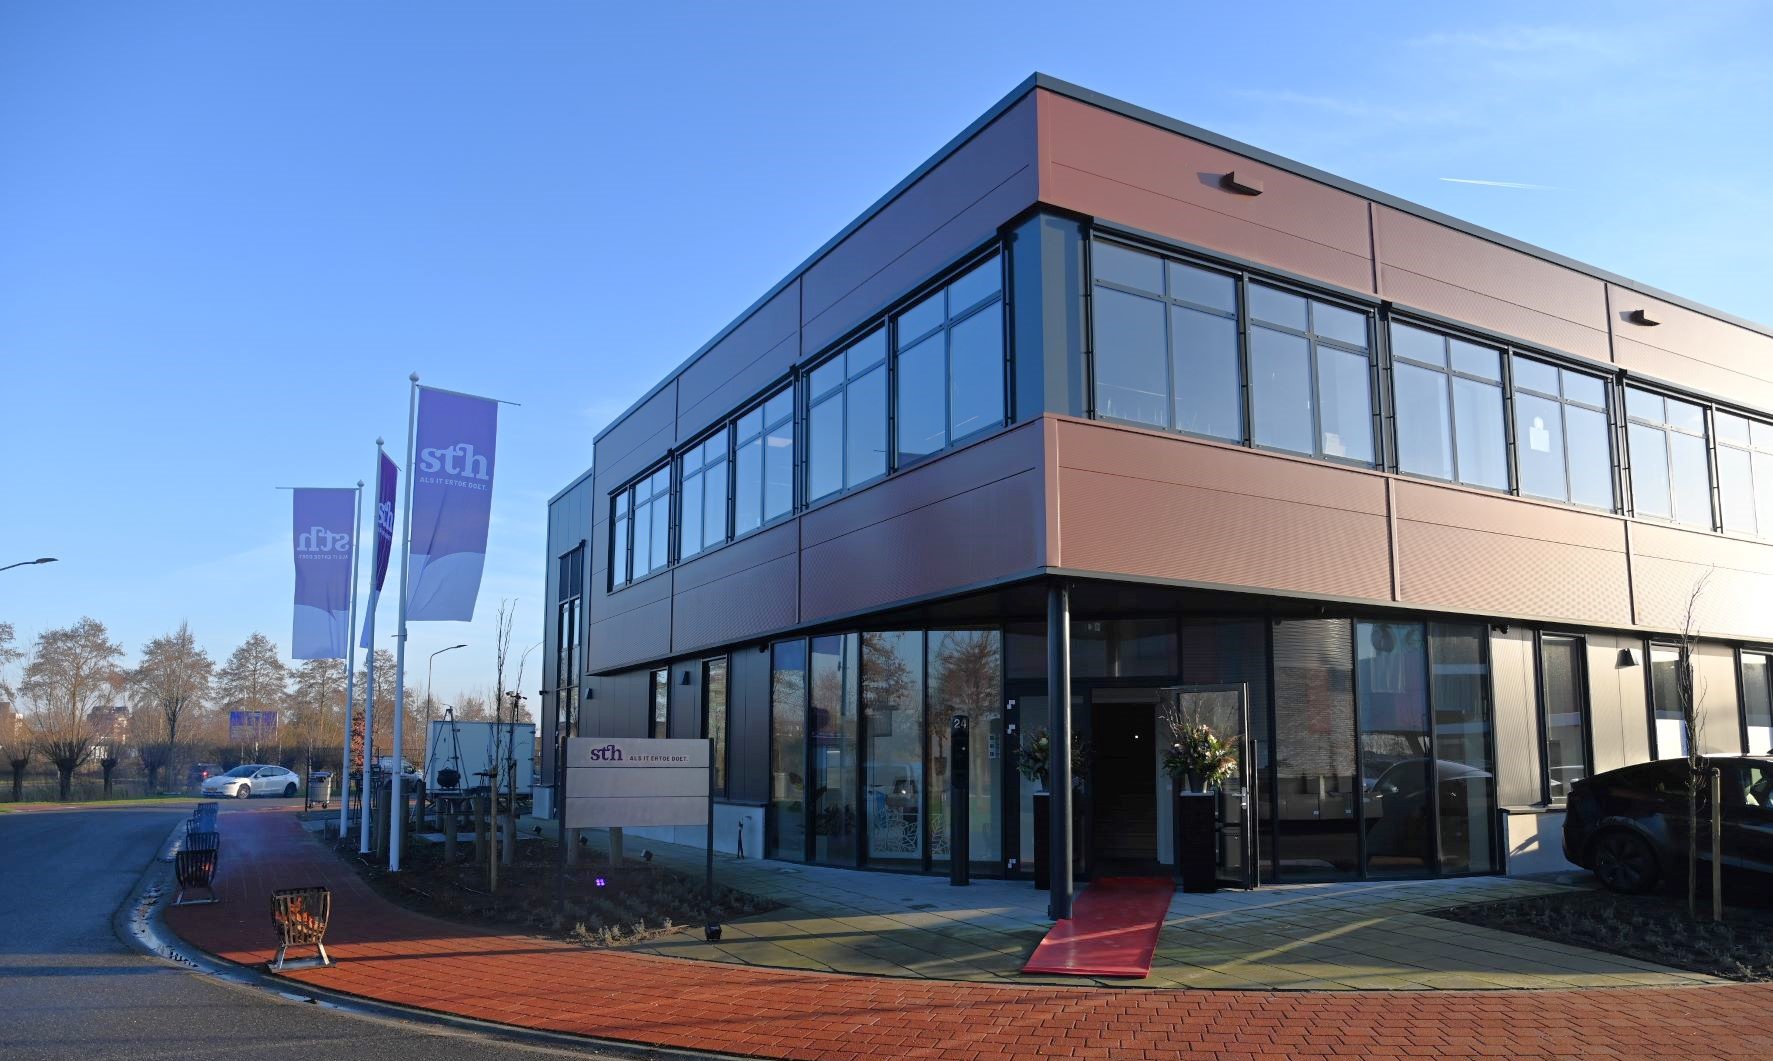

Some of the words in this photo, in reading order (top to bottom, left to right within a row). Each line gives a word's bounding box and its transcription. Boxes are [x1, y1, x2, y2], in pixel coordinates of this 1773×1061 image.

[420, 443, 489, 480] sth
[953, 718, 967, 728] 24
[590, 744, 623, 761] sth
